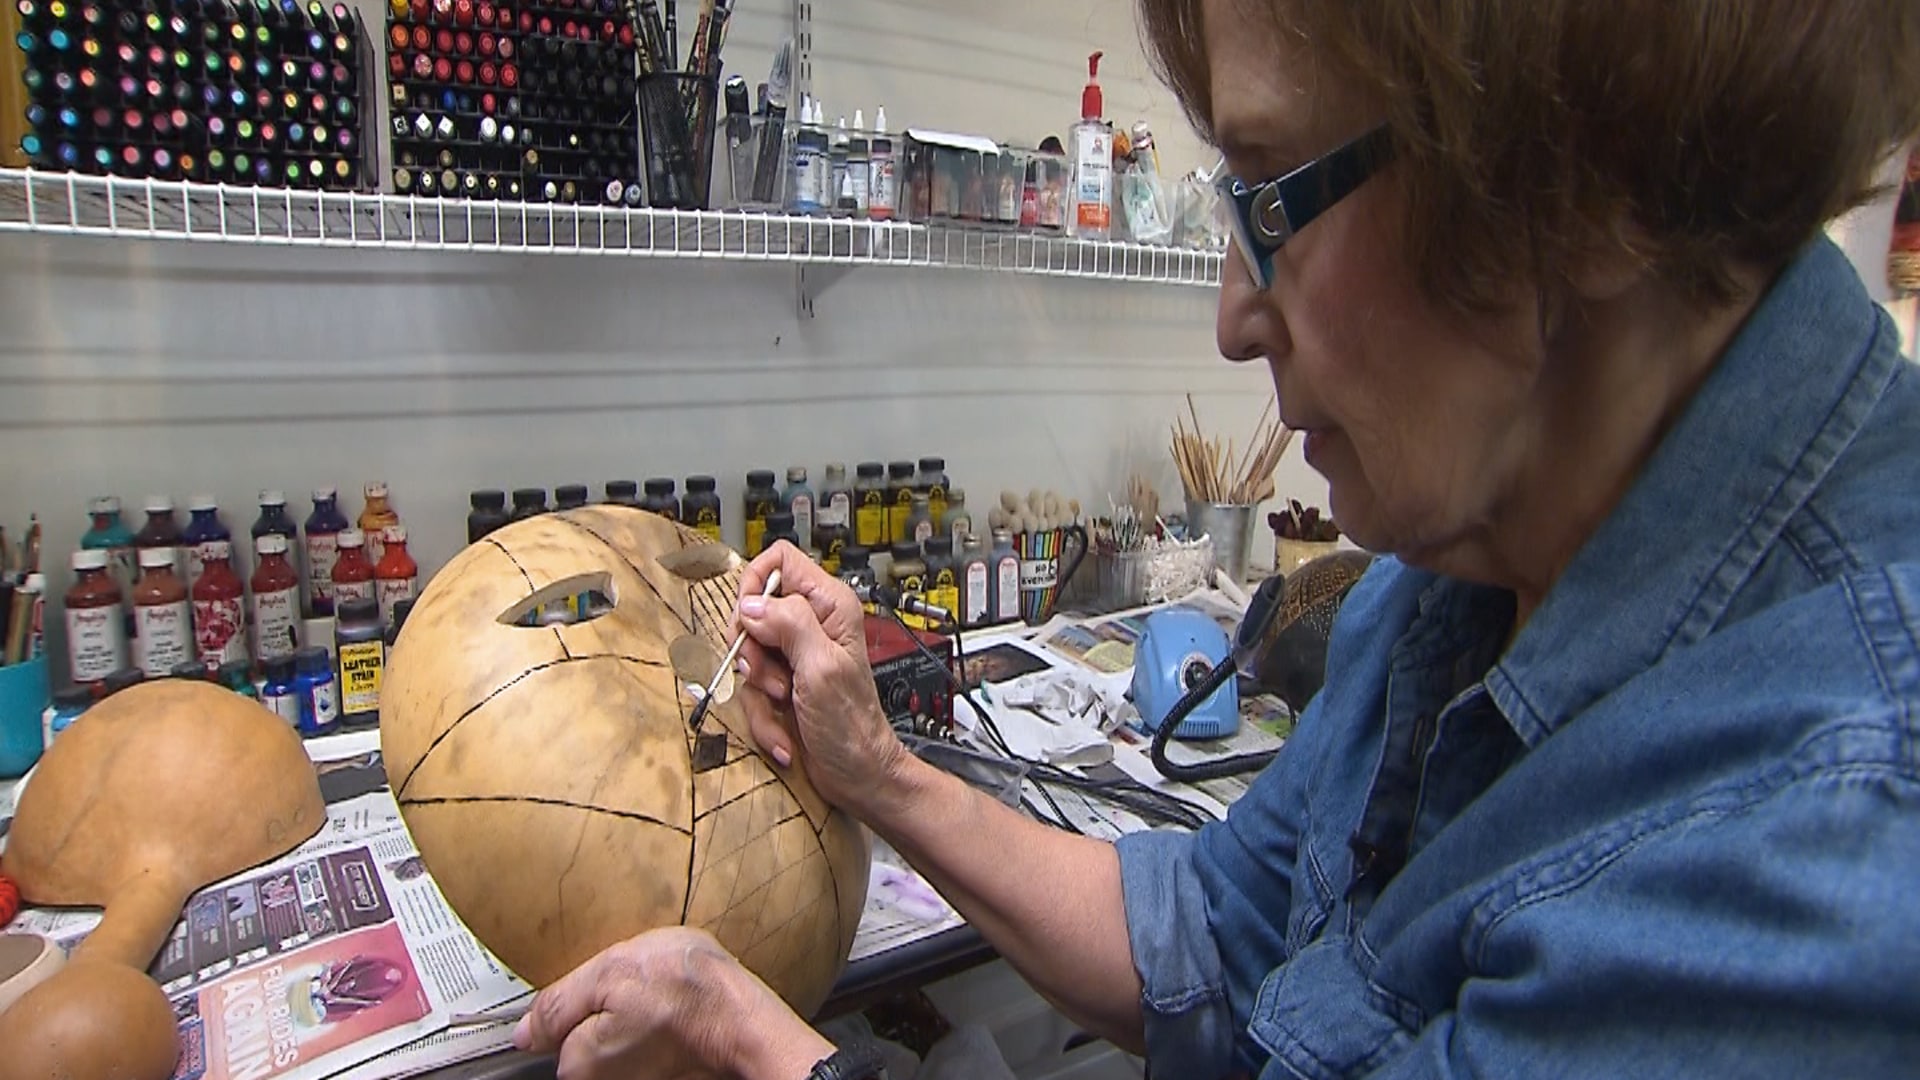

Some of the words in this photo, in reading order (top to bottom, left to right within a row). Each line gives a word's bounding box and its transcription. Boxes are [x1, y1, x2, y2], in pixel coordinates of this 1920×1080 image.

[344, 656, 381, 671] LEATHER
[351, 669, 376, 683] STAIN
[222, 978, 273, 1080] AGAIN
